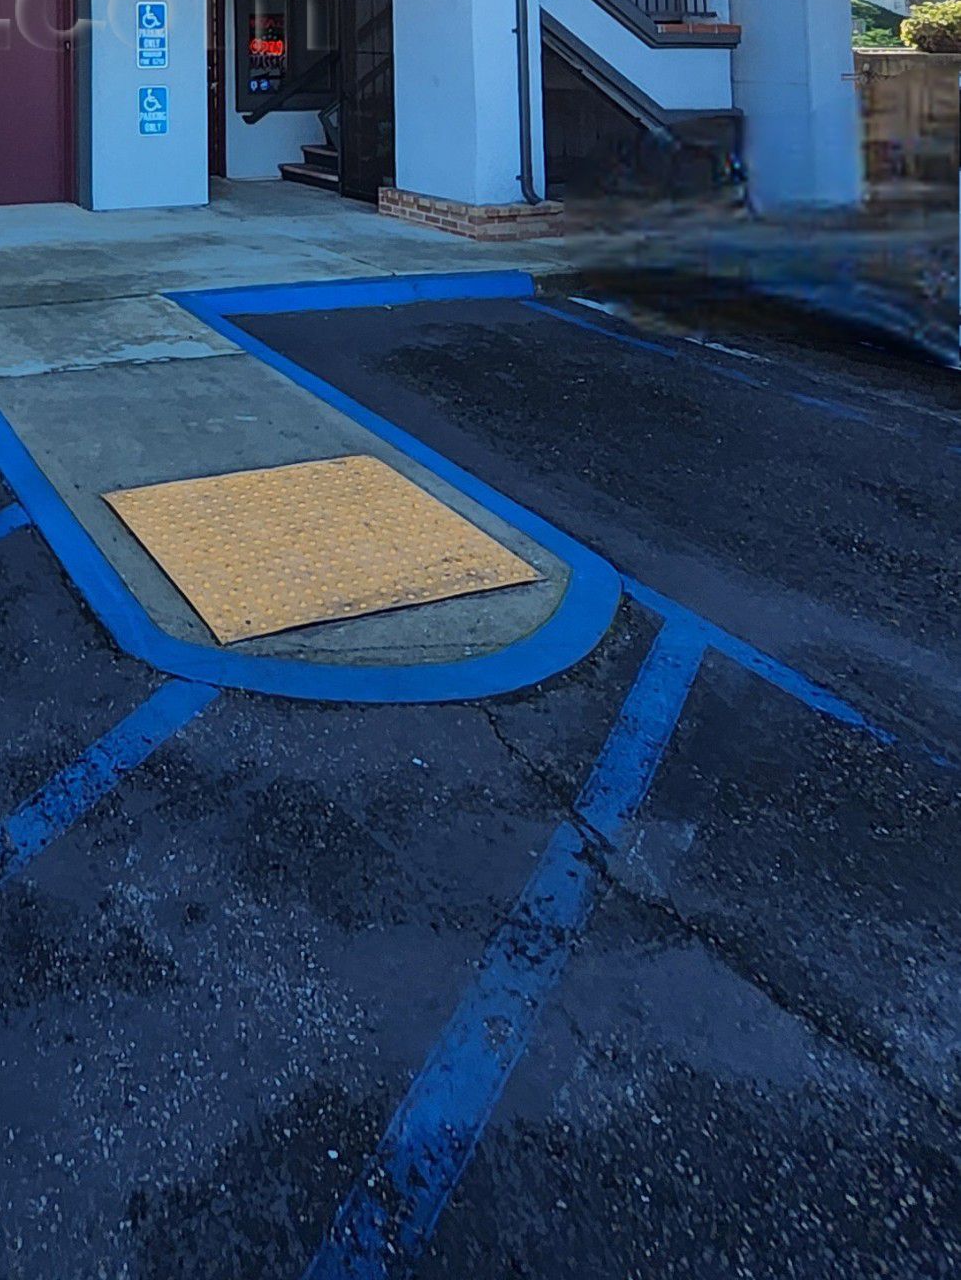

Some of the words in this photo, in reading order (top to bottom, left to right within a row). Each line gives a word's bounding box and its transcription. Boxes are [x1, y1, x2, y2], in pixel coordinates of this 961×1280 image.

[139, 29, 165, 38] PARKING
[144, 38, 160, 48] ONLY
[251, 39, 283, 55] OPEN
[140, 112, 166, 121] PARKING
[145, 123, 161, 132] ONLY
